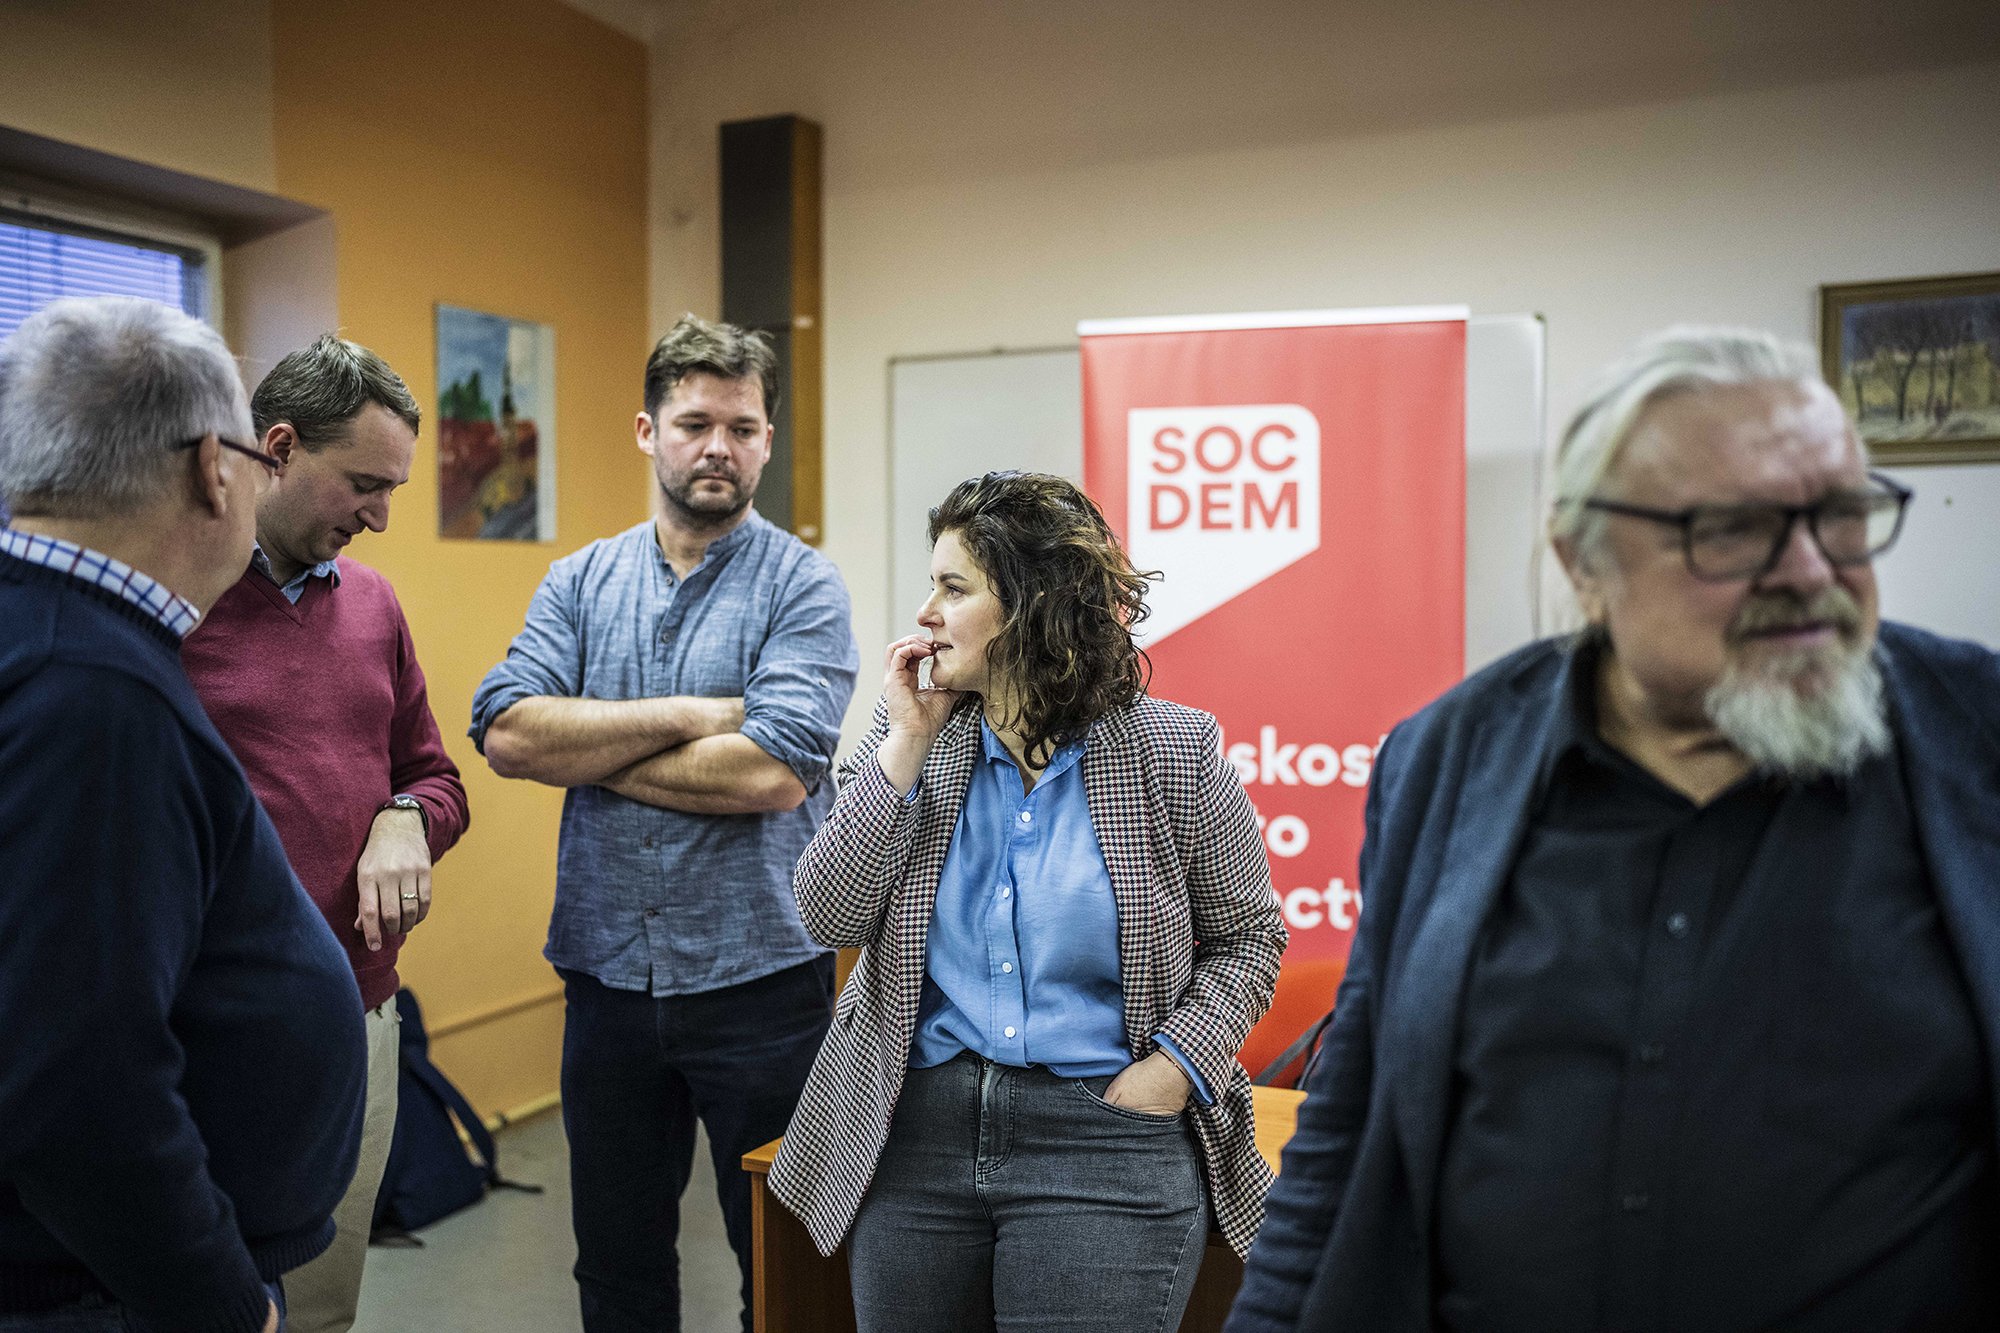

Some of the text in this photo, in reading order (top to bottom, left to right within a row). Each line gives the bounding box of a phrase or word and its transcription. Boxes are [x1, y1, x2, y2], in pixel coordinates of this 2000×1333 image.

[1151, 423, 1298, 474] SOC
[1148, 481, 1299, 531] DEM
[1216, 724, 1389, 788] skos
